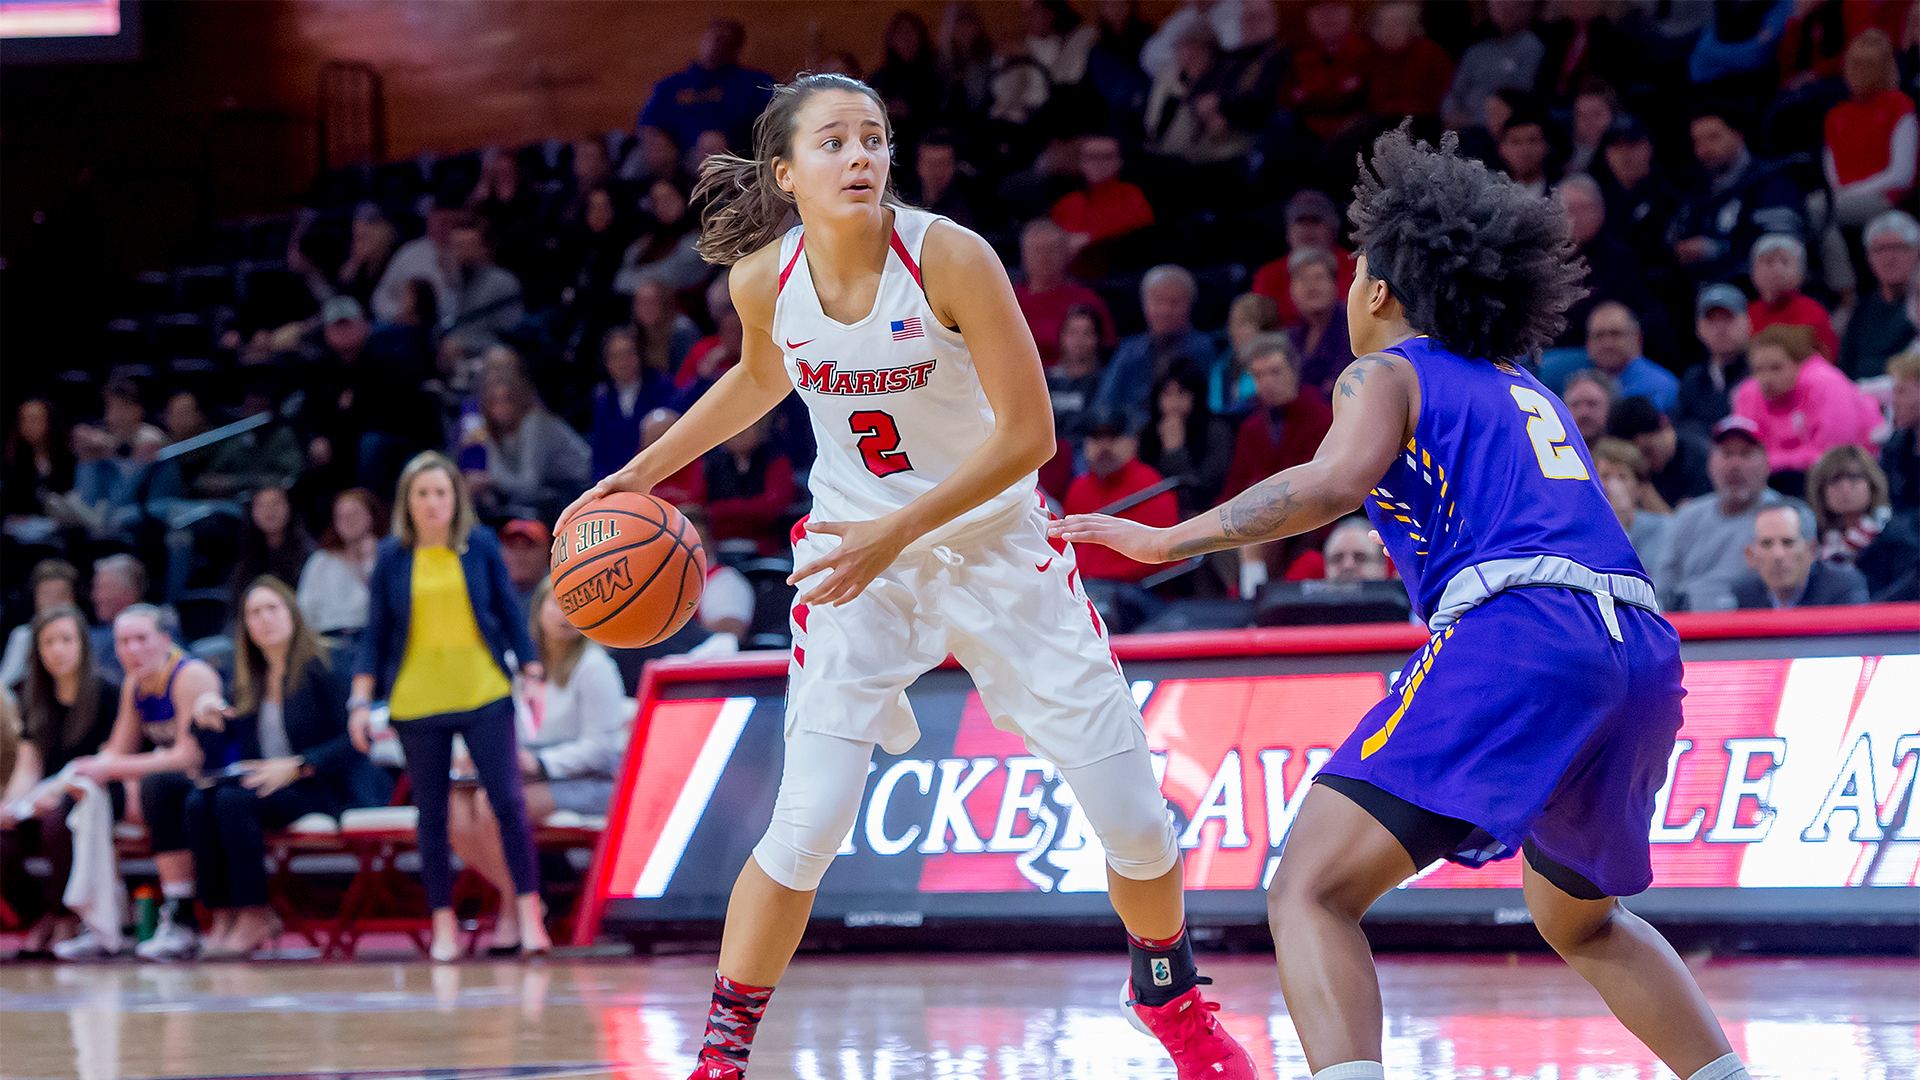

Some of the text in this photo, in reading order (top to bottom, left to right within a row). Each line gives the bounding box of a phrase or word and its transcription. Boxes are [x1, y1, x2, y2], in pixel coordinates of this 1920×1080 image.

[848, 410, 914, 478] 2
[1510, 384, 1590, 480] 2
[575, 519, 621, 555] THE
[558, 556, 634, 616] MARIS
